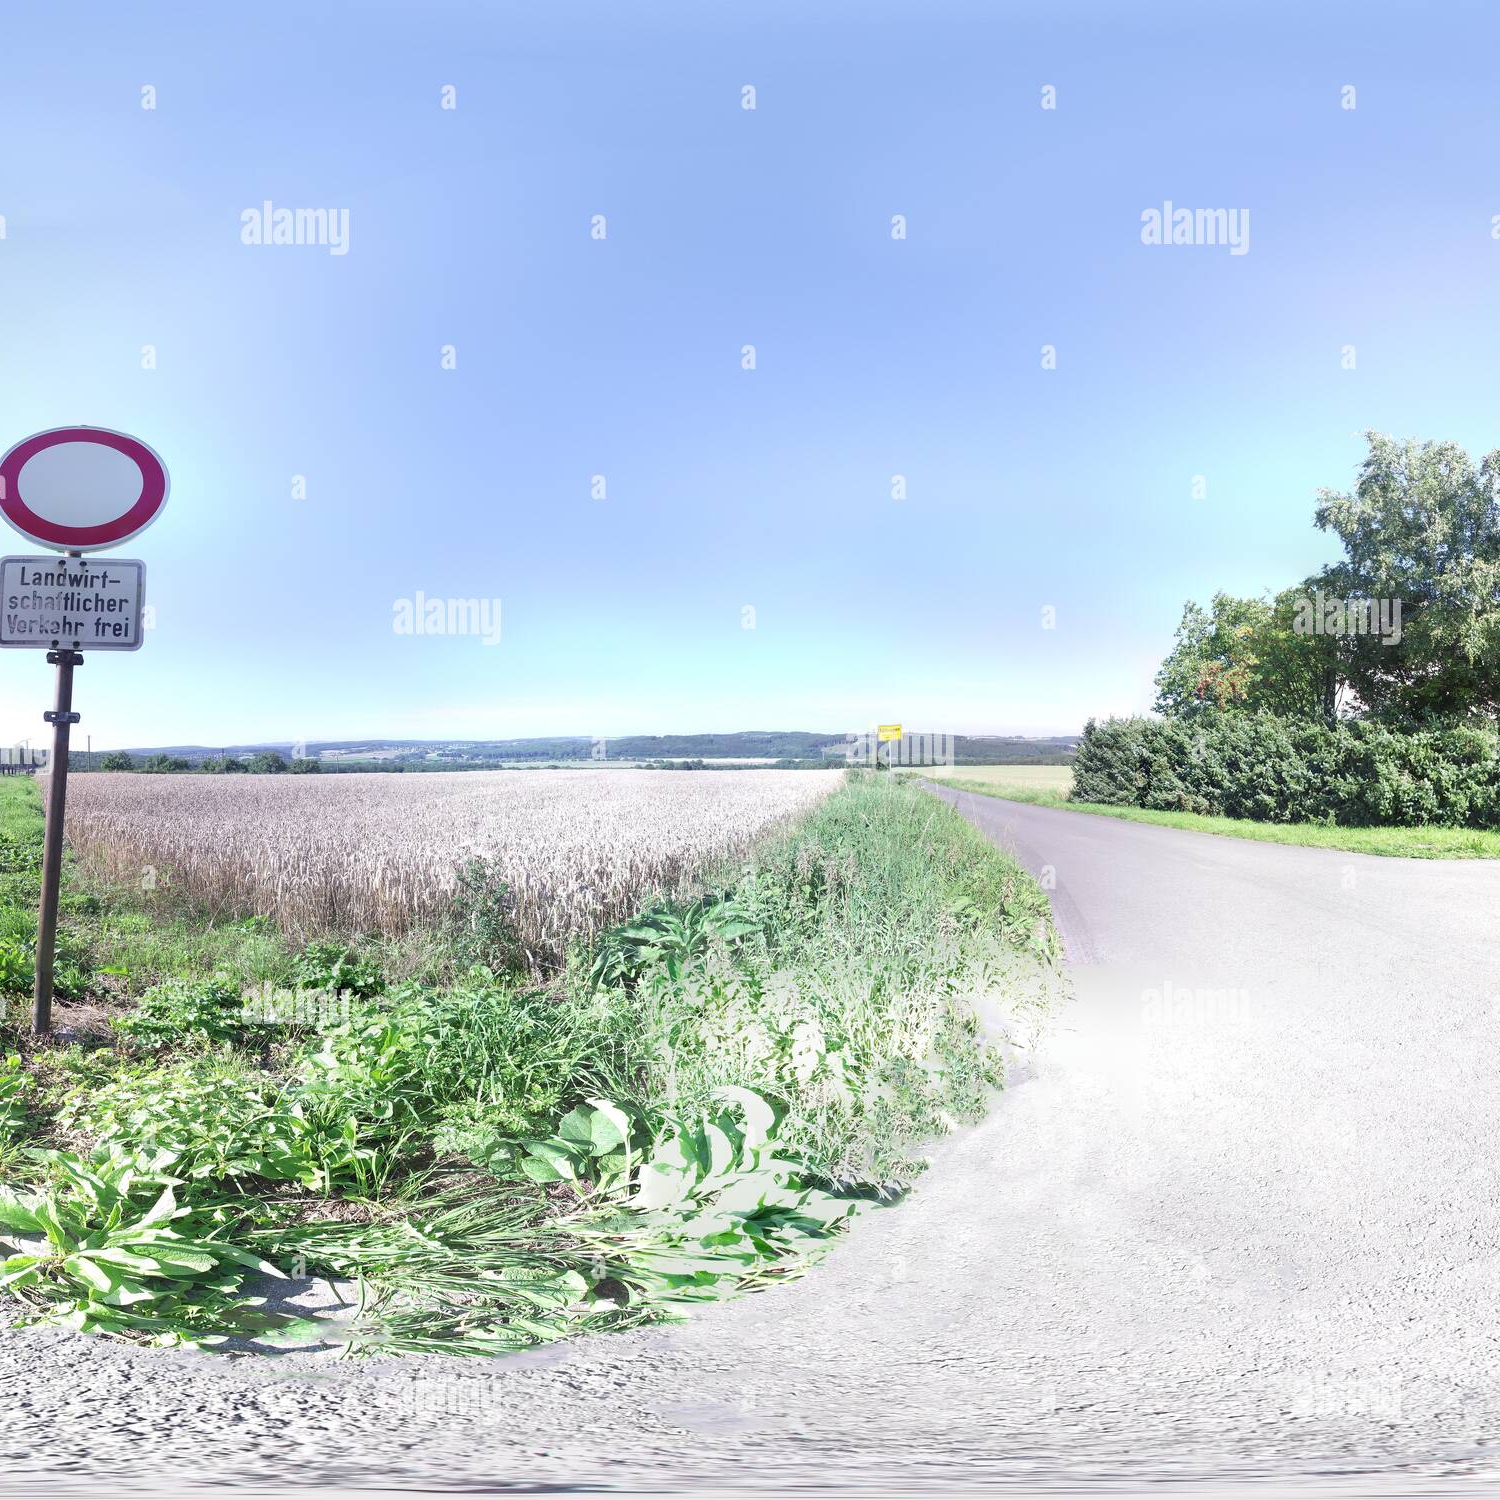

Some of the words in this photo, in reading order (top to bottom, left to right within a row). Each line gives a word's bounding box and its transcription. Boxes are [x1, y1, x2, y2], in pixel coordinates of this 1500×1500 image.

[20, 566, 121, 589] Landwirt-
[8, 590, 129, 613] schaftlicher
[7, 614, 85, 636] Verkehr
[94, 617, 130, 637] frei
